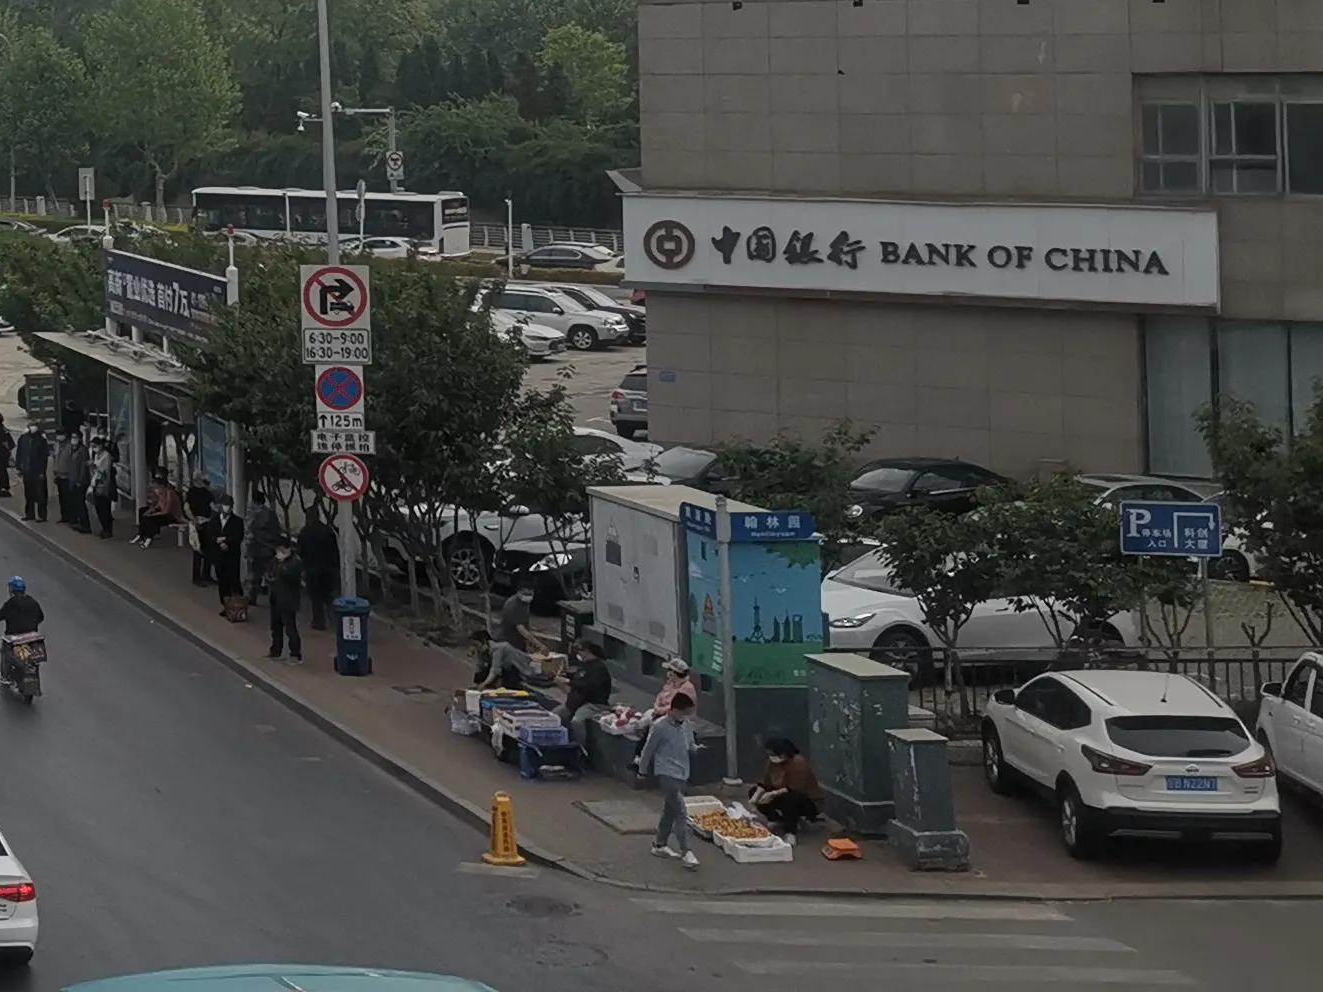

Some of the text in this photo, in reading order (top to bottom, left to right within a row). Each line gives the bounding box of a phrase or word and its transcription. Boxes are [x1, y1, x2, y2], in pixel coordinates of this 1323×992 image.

[711, 225, 866, 270] 中国银行
[880, 241, 1170, 275] BANK OF CHINA
[308, 332, 365, 345] 6:30-9:00
[305, 346, 369, 360] 16:30-19:00
[329, 415, 363, 428] 125m
[743, 515, 801, 529] 翰林园
[1125, 507, 1152, 538] P
[1141, 528, 1172, 538] 停车场
[1184, 527, 1209, 538] 科创
[1146, 539, 1167, 548] 入口
